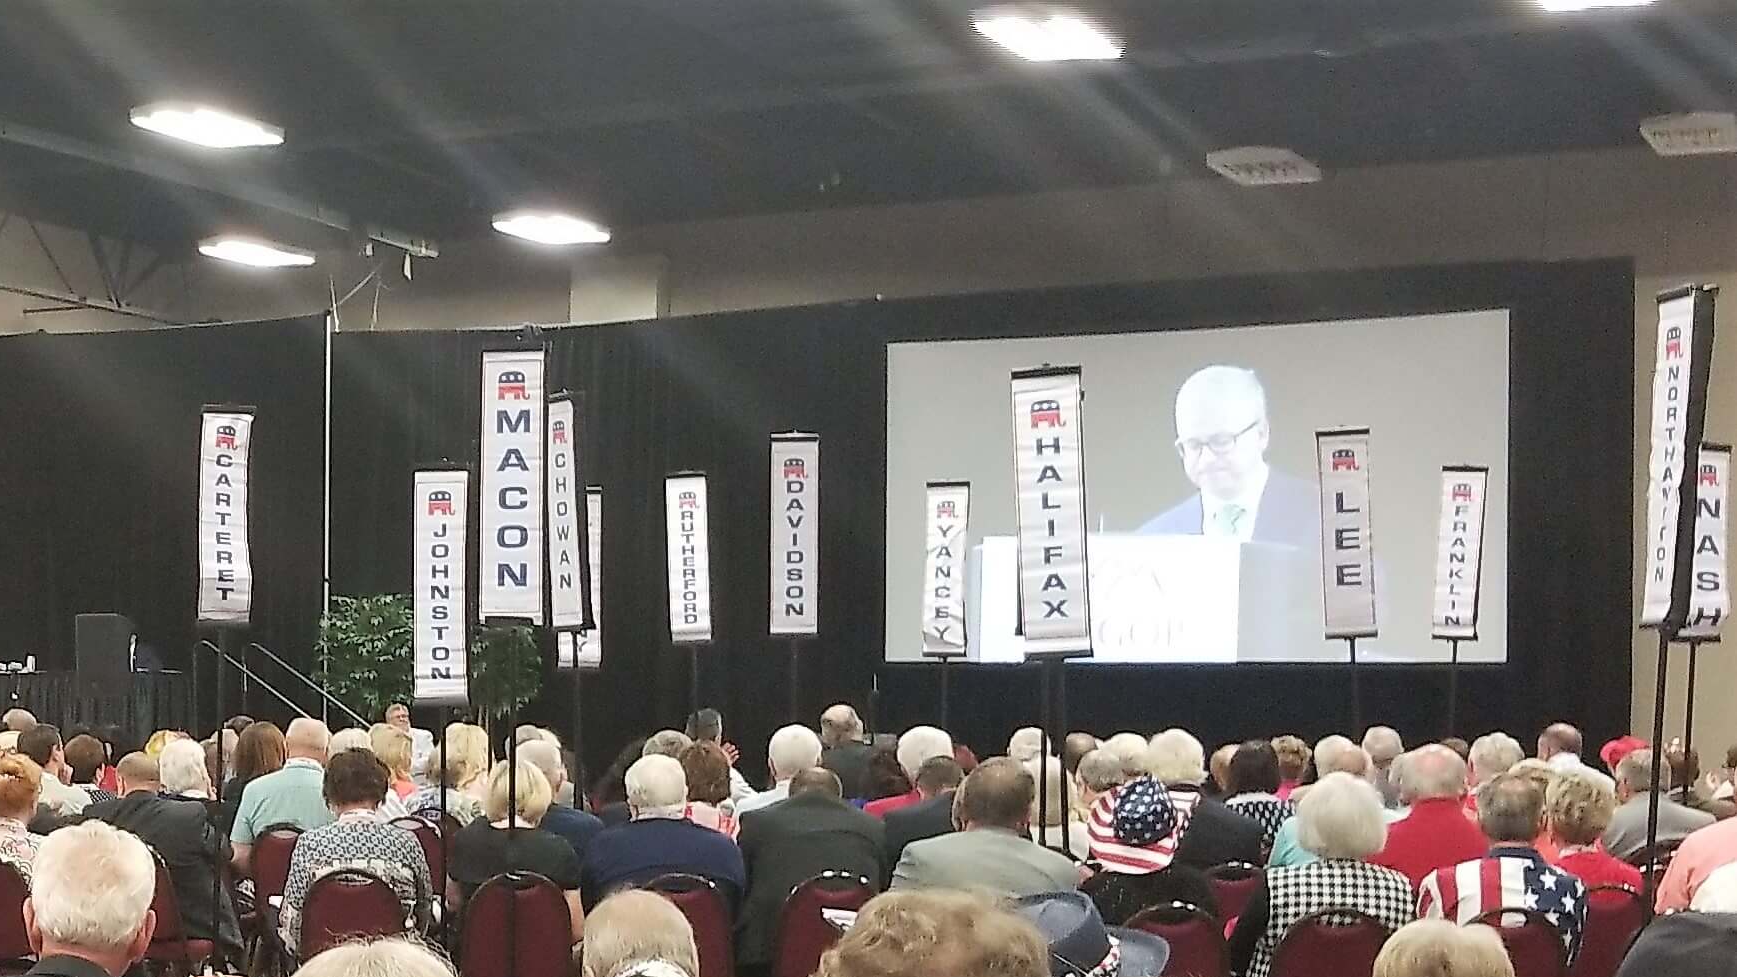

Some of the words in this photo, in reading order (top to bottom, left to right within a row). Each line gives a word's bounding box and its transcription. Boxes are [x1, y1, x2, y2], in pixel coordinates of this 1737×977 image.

[216, 453, 234, 600] CARTERET
[496, 409, 531, 587] MACON
[555, 453, 573, 589] CHOWAN
[785, 481, 804, 617] DAVIDSON
[1036, 439, 1069, 618] HALIFAX
[1335, 492, 1362, 586] LEE
[1444, 505, 1468, 626] FRANKLIN
[1697, 498, 1721, 626] NASH
[430, 523, 451, 680] JOHNSTON
[681, 511, 698, 624] RUTHERFORD
[934, 525, 955, 642] YANCEY
